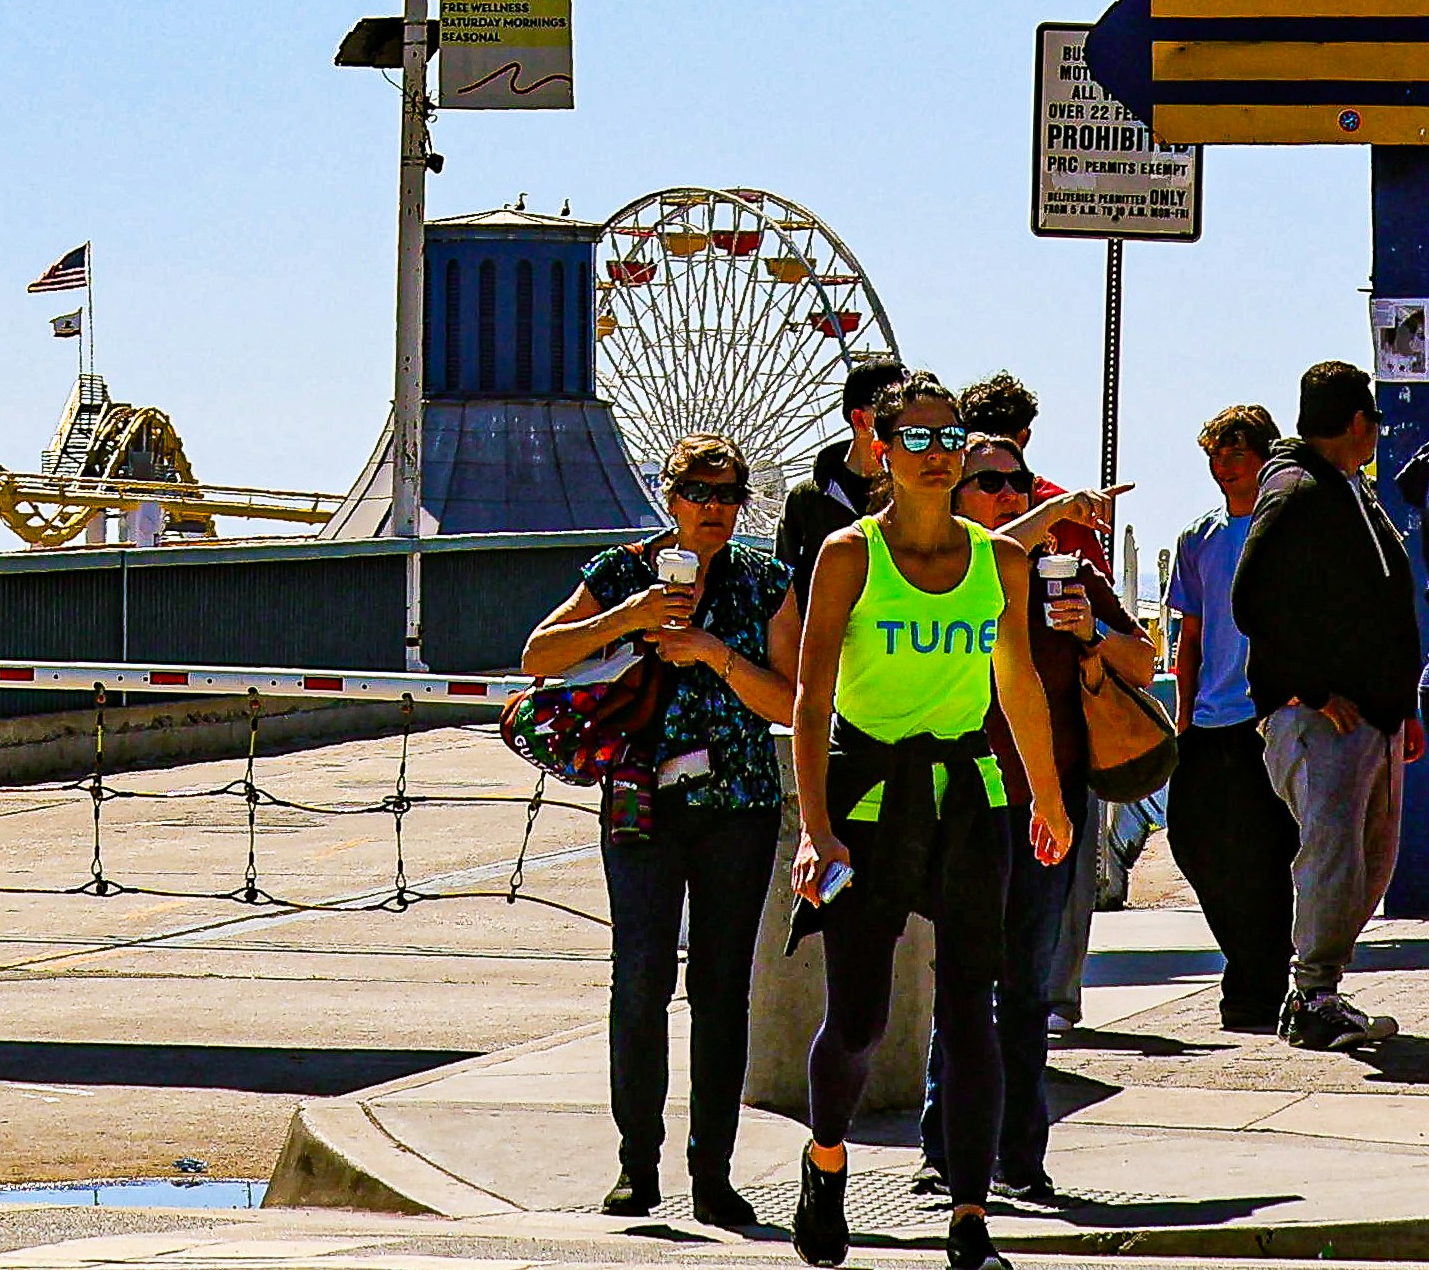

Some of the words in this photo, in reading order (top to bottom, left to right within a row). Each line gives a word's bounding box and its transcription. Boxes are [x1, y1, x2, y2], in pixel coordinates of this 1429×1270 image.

[470, 2, 530, 13] WELLNESS
[442, 17, 502, 28] SATURDAY
[503, 17, 567, 28] MORNINGS
[442, 32, 501, 42] SEASONAL
[1072, 85, 1096, 101] ALL
[1048, 103, 1085, 119] OVER
[1091, 105, 1110, 121] 22
[1047, 124, 1190, 154] PROHIBIT
[1047, 156, 1079, 174] PRC
[1085, 160, 1137, 175] PERMITS
[1141, 162, 1189, 177] EXEMPT
[1149, 189, 1187, 207] ONLY
